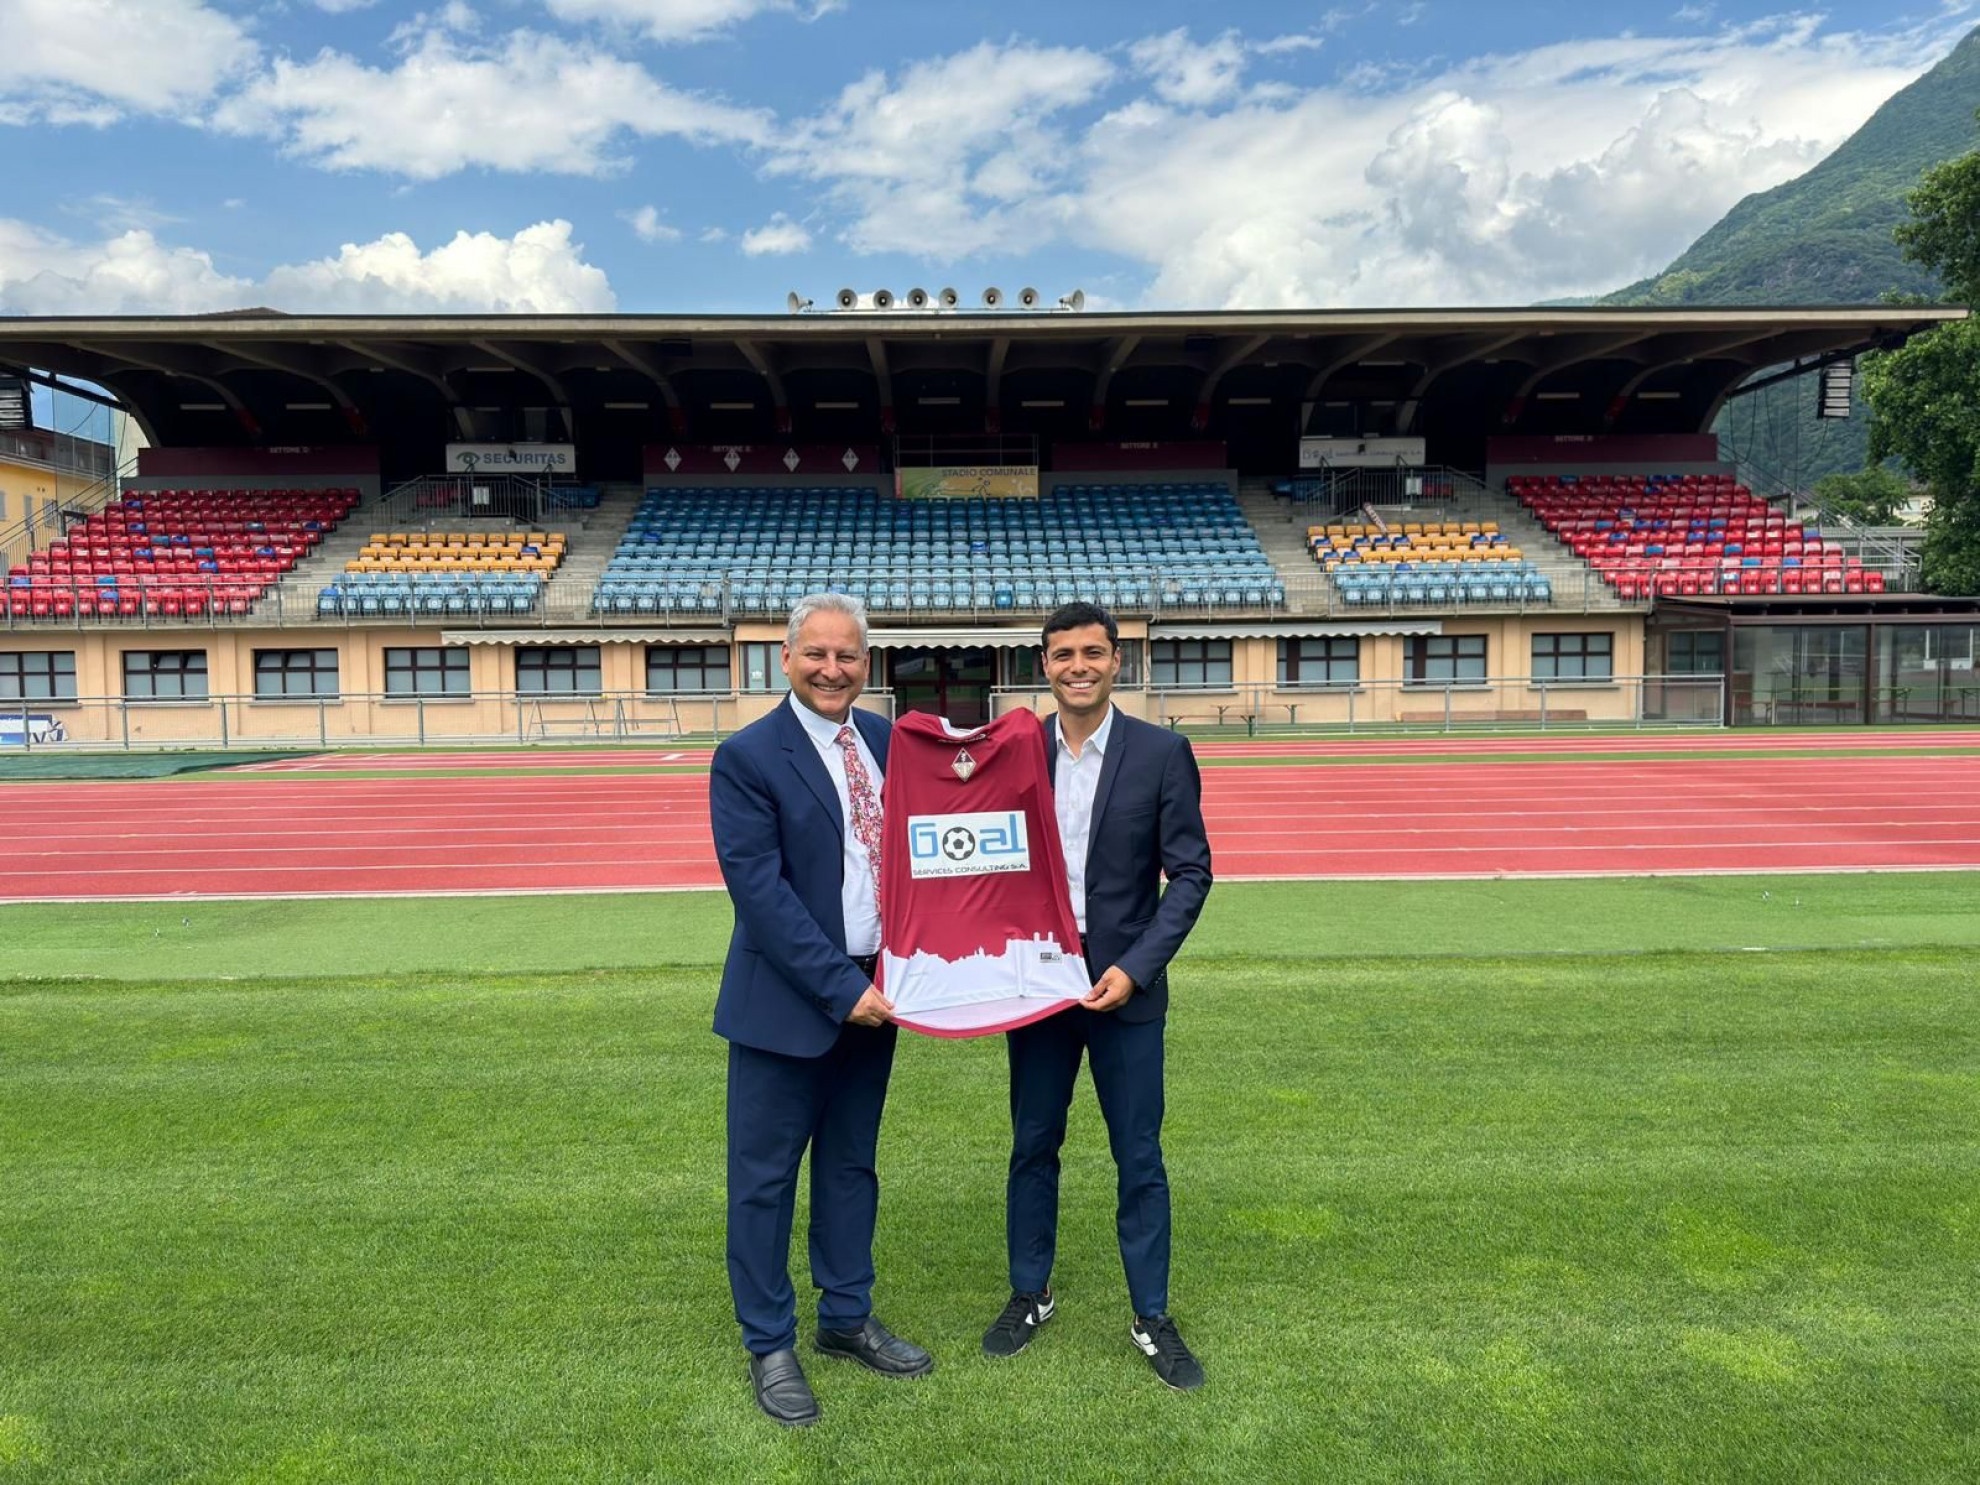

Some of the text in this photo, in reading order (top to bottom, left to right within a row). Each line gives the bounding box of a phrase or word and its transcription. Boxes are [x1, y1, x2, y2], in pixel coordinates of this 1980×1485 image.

[482, 452, 567, 464] SECURITAS
[941, 468, 1036, 477] STADIO COMUNALE
[912, 866, 954, 876] SERVICES
[954, 863, 1009, 874] CONSULTING
